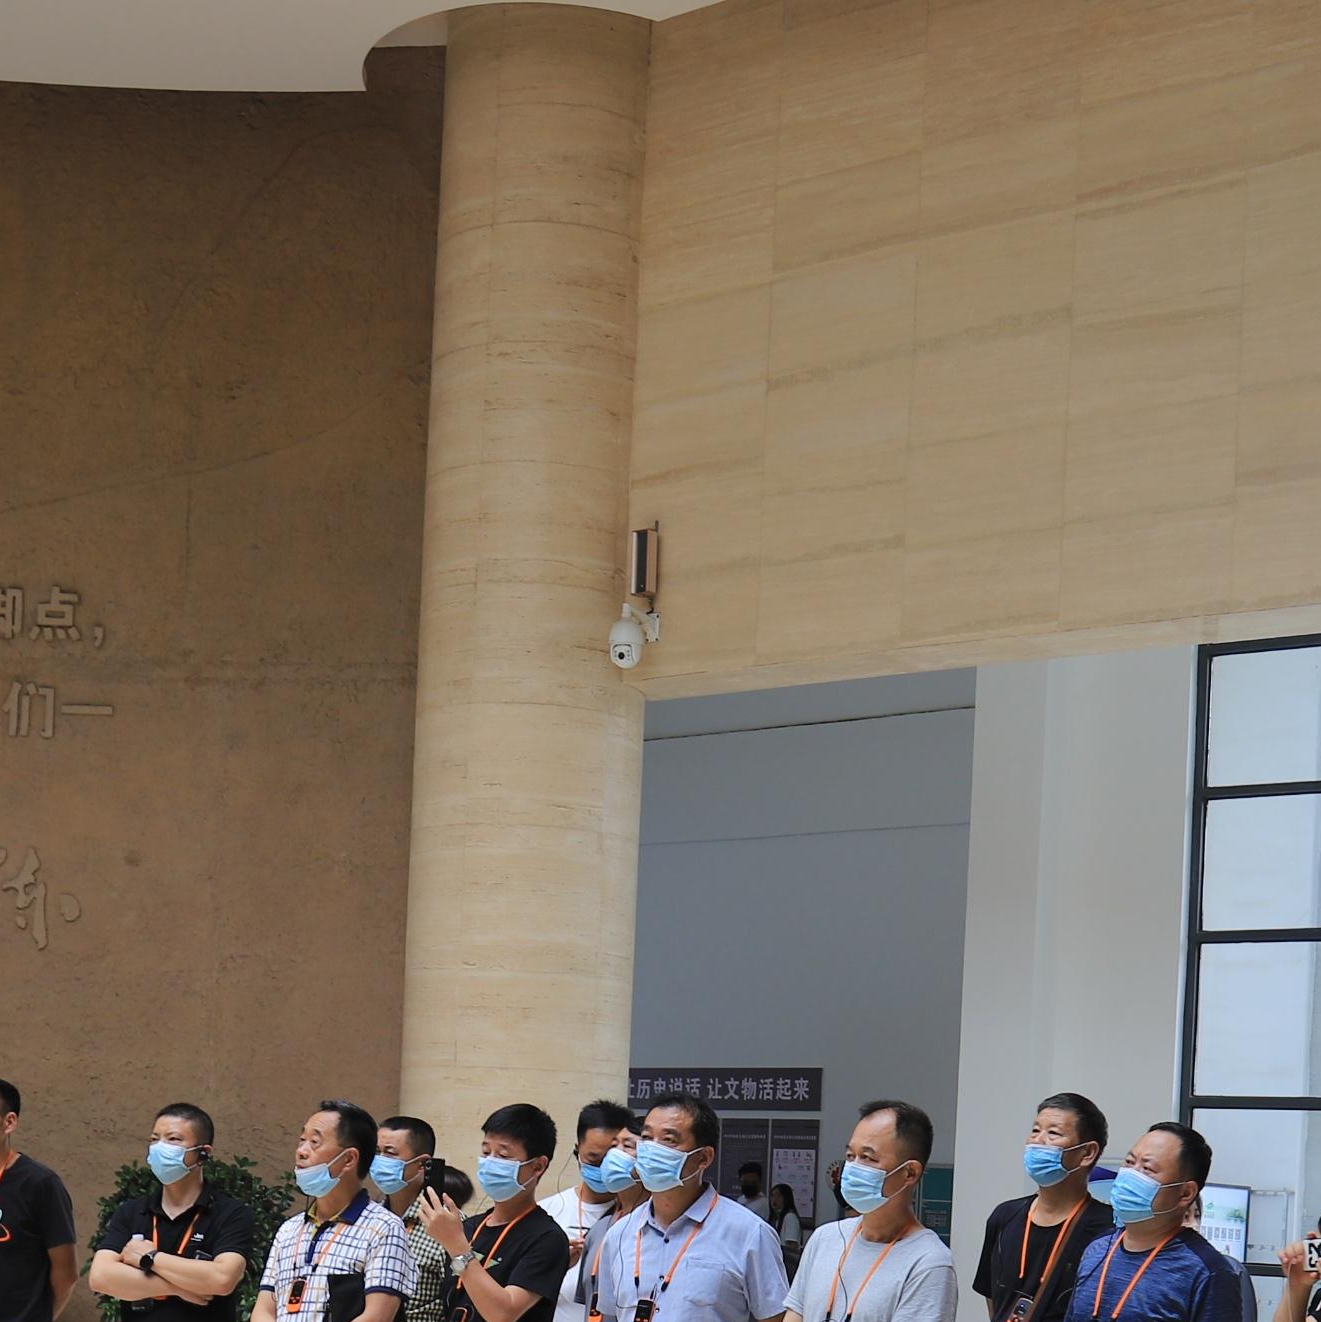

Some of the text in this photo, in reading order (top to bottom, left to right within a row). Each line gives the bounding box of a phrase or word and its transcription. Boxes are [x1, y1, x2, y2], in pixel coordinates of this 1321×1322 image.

[706, 1077, 810, 1101] 让文物活起来
